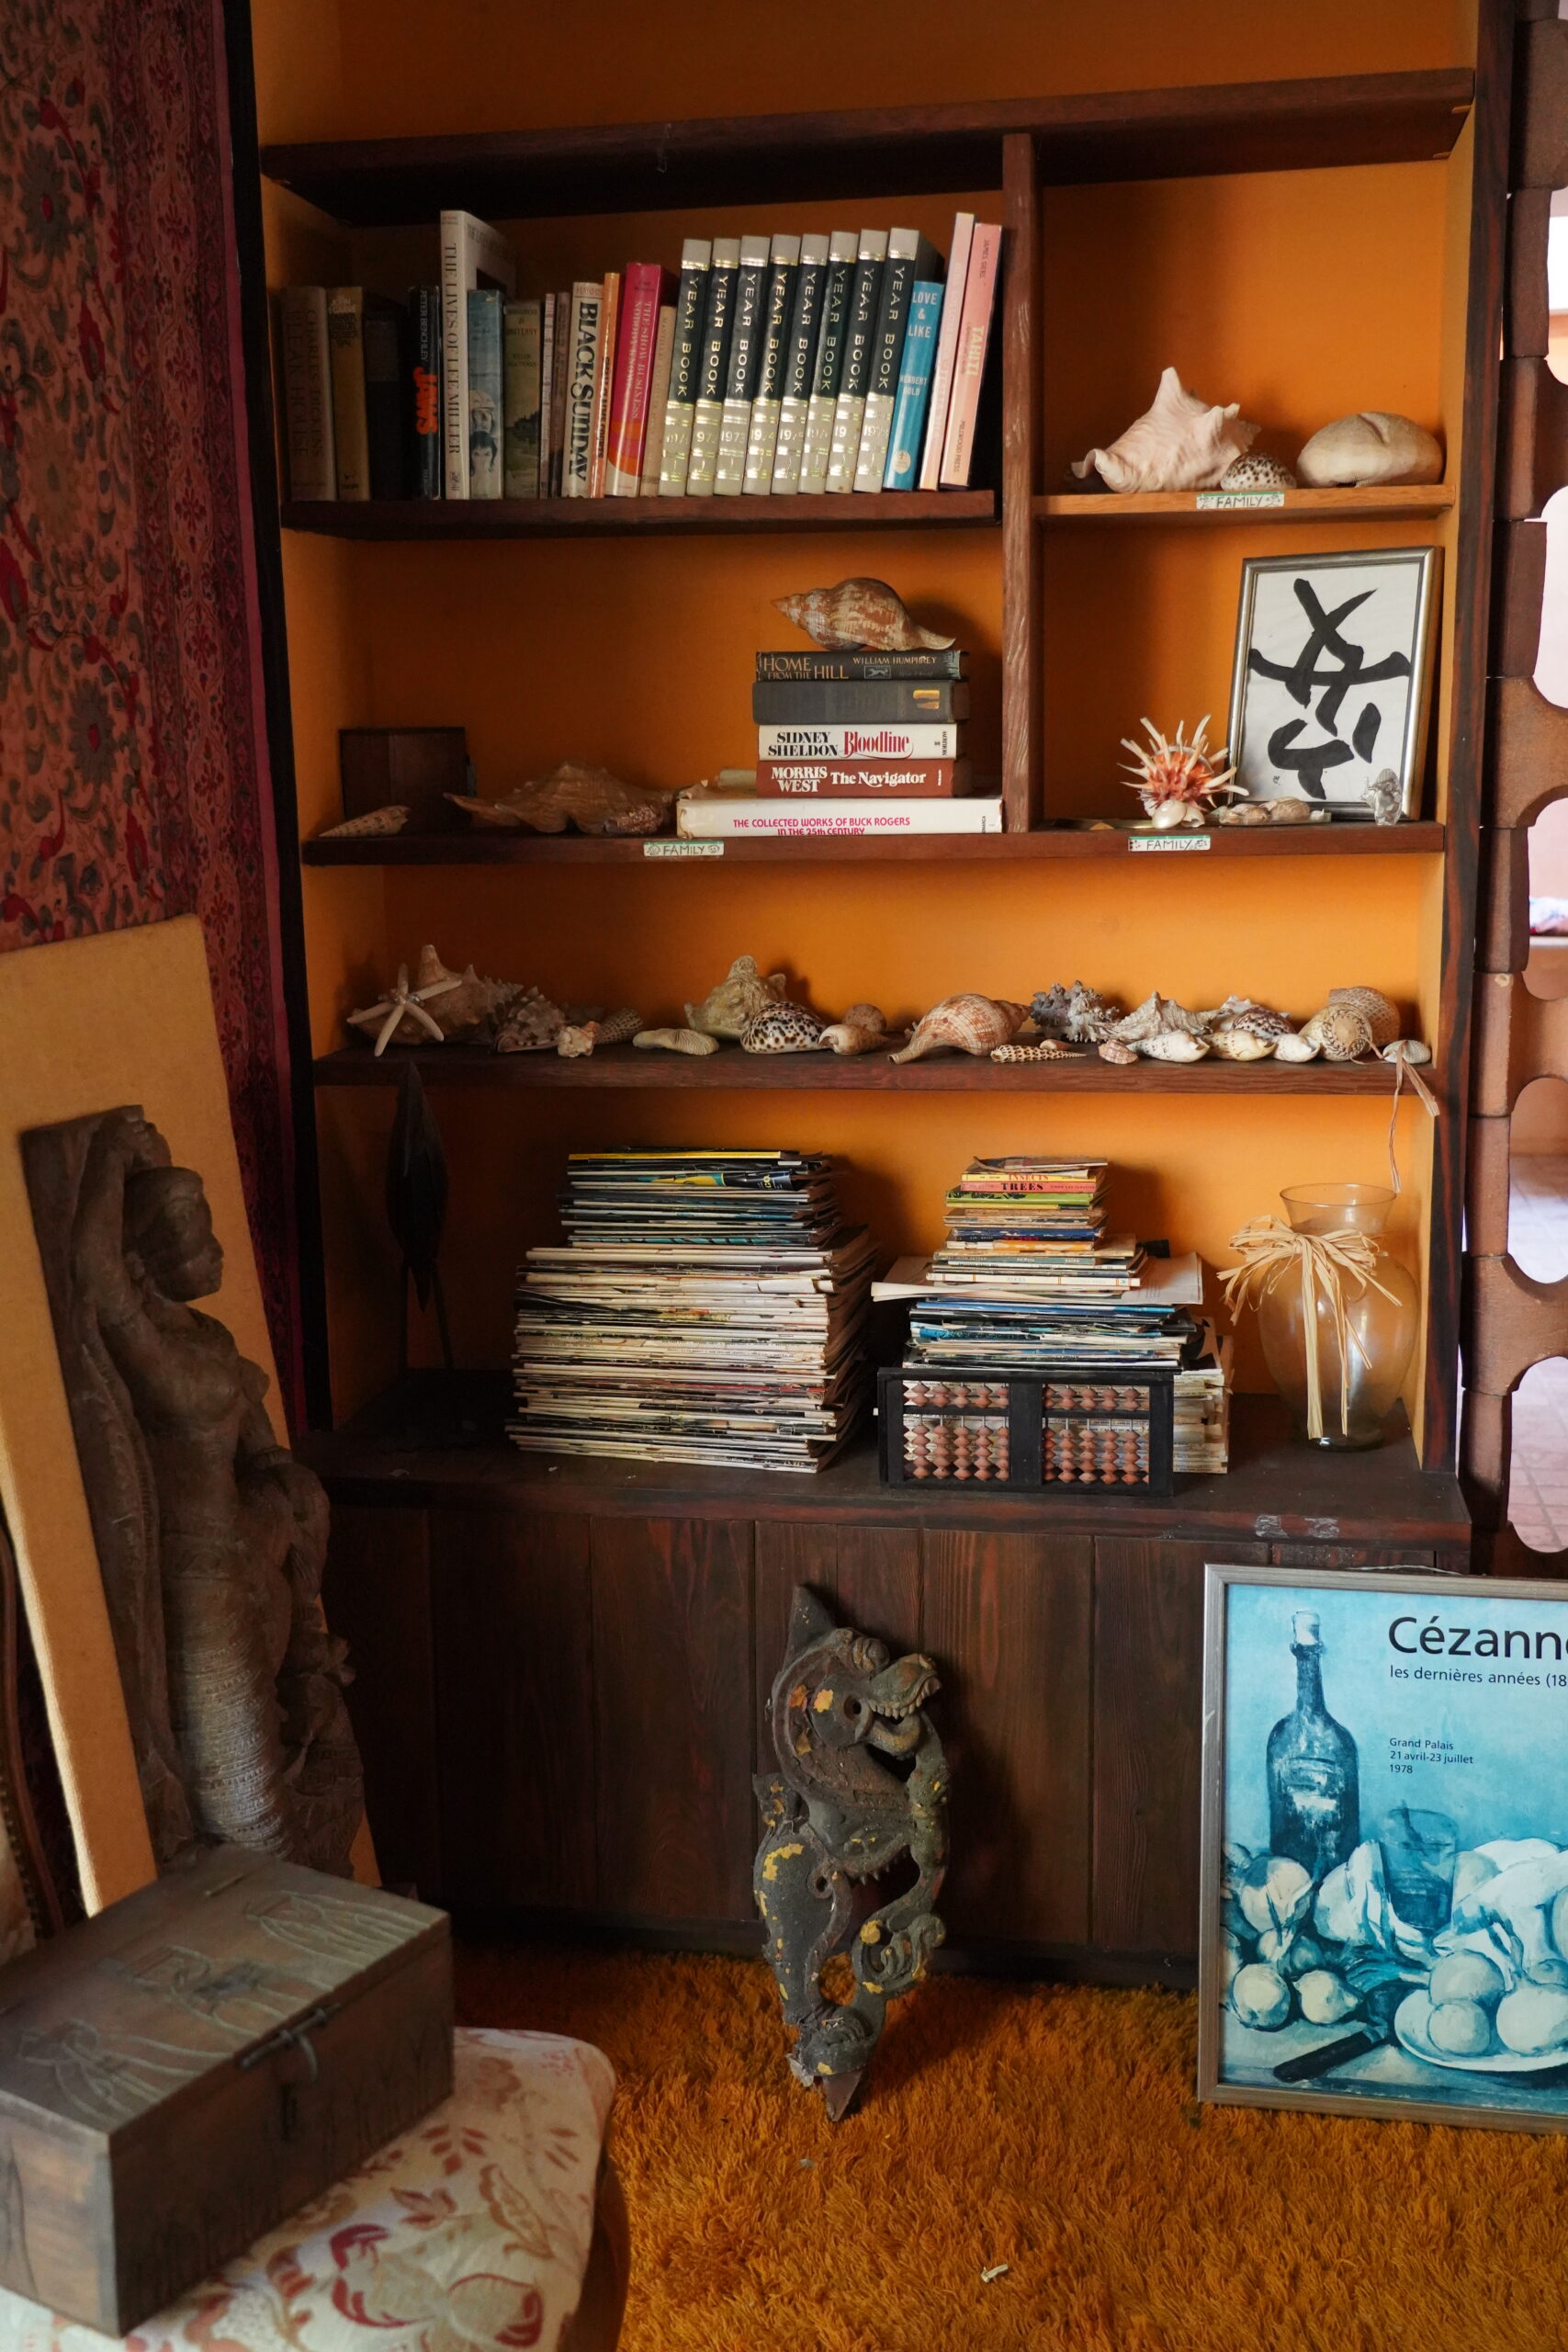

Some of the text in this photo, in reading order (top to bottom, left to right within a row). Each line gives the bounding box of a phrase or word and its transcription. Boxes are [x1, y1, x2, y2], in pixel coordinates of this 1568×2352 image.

[912, 292, 937, 306] LOVE
[641, 301, 652, 327] THE
[917, 310, 926, 320] &
[678, 277, 699, 397] YEAR BOOK
[706, 275, 728, 395] YEAR BOOK
[735, 273, 756, 394] YEAR BOOK
[764, 272, 787, 393] YEAR BOOK
[794, 273, 817, 393] YEAR BOOK
[820, 269, 845, 390] YEAR BOOK
[849, 267, 874, 390] YEAR BOOK
[878, 266, 905, 389] YEAR BOOK
[908, 325, 931, 338] LIKE
[445, 243, 461, 454] THE LIVES OF LEE MILLER
[573, 301, 598, 381] BLACK
[637, 330, 650, 361] SHOW
[967, 325, 985, 377] TAHITI
[413, 366, 438, 435] JAWS
[632, 365, 647, 420] BUSINESS
[953, 454, 963, 473] PRESS
[1216, 497, 1262, 508] FAMILY
[764, 657, 811, 673] HOME
[853, 656, 937, 665] WILLIAM HUMPHREY
[769, 665, 849, 680] FROM THE HILL
[777, 731, 830, 743] SIDNEY
[839, 731, 914, 759] Bloodline
[768, 744, 838, 756] SHELDON
[772, 766, 828, 779] MORRIS
[830, 772, 856, 785] The
[858, 772, 926, 788] Navigator
[777, 779, 820, 793] WEST
[733, 817, 911, 828] THE COLLECTED WORKS OF BUCK ROGERS
[1147, 840, 1191, 850] FAMILY
[1001, 1182, 1043, 1191] TREES
[1389, 1616, 1568, 1660] Cézann
[1390, 1665, 1409, 1678] les
[1414, 1667, 1483, 1682] dernières
[1488, 1672, 1540, 1685] années
[1390, 1737, 1454, 1750] Grand Palais
[1390, 1750, 1473, 1765] 21 avril-23 juillet
[1390, 1764, 1413, 1774] 1978
